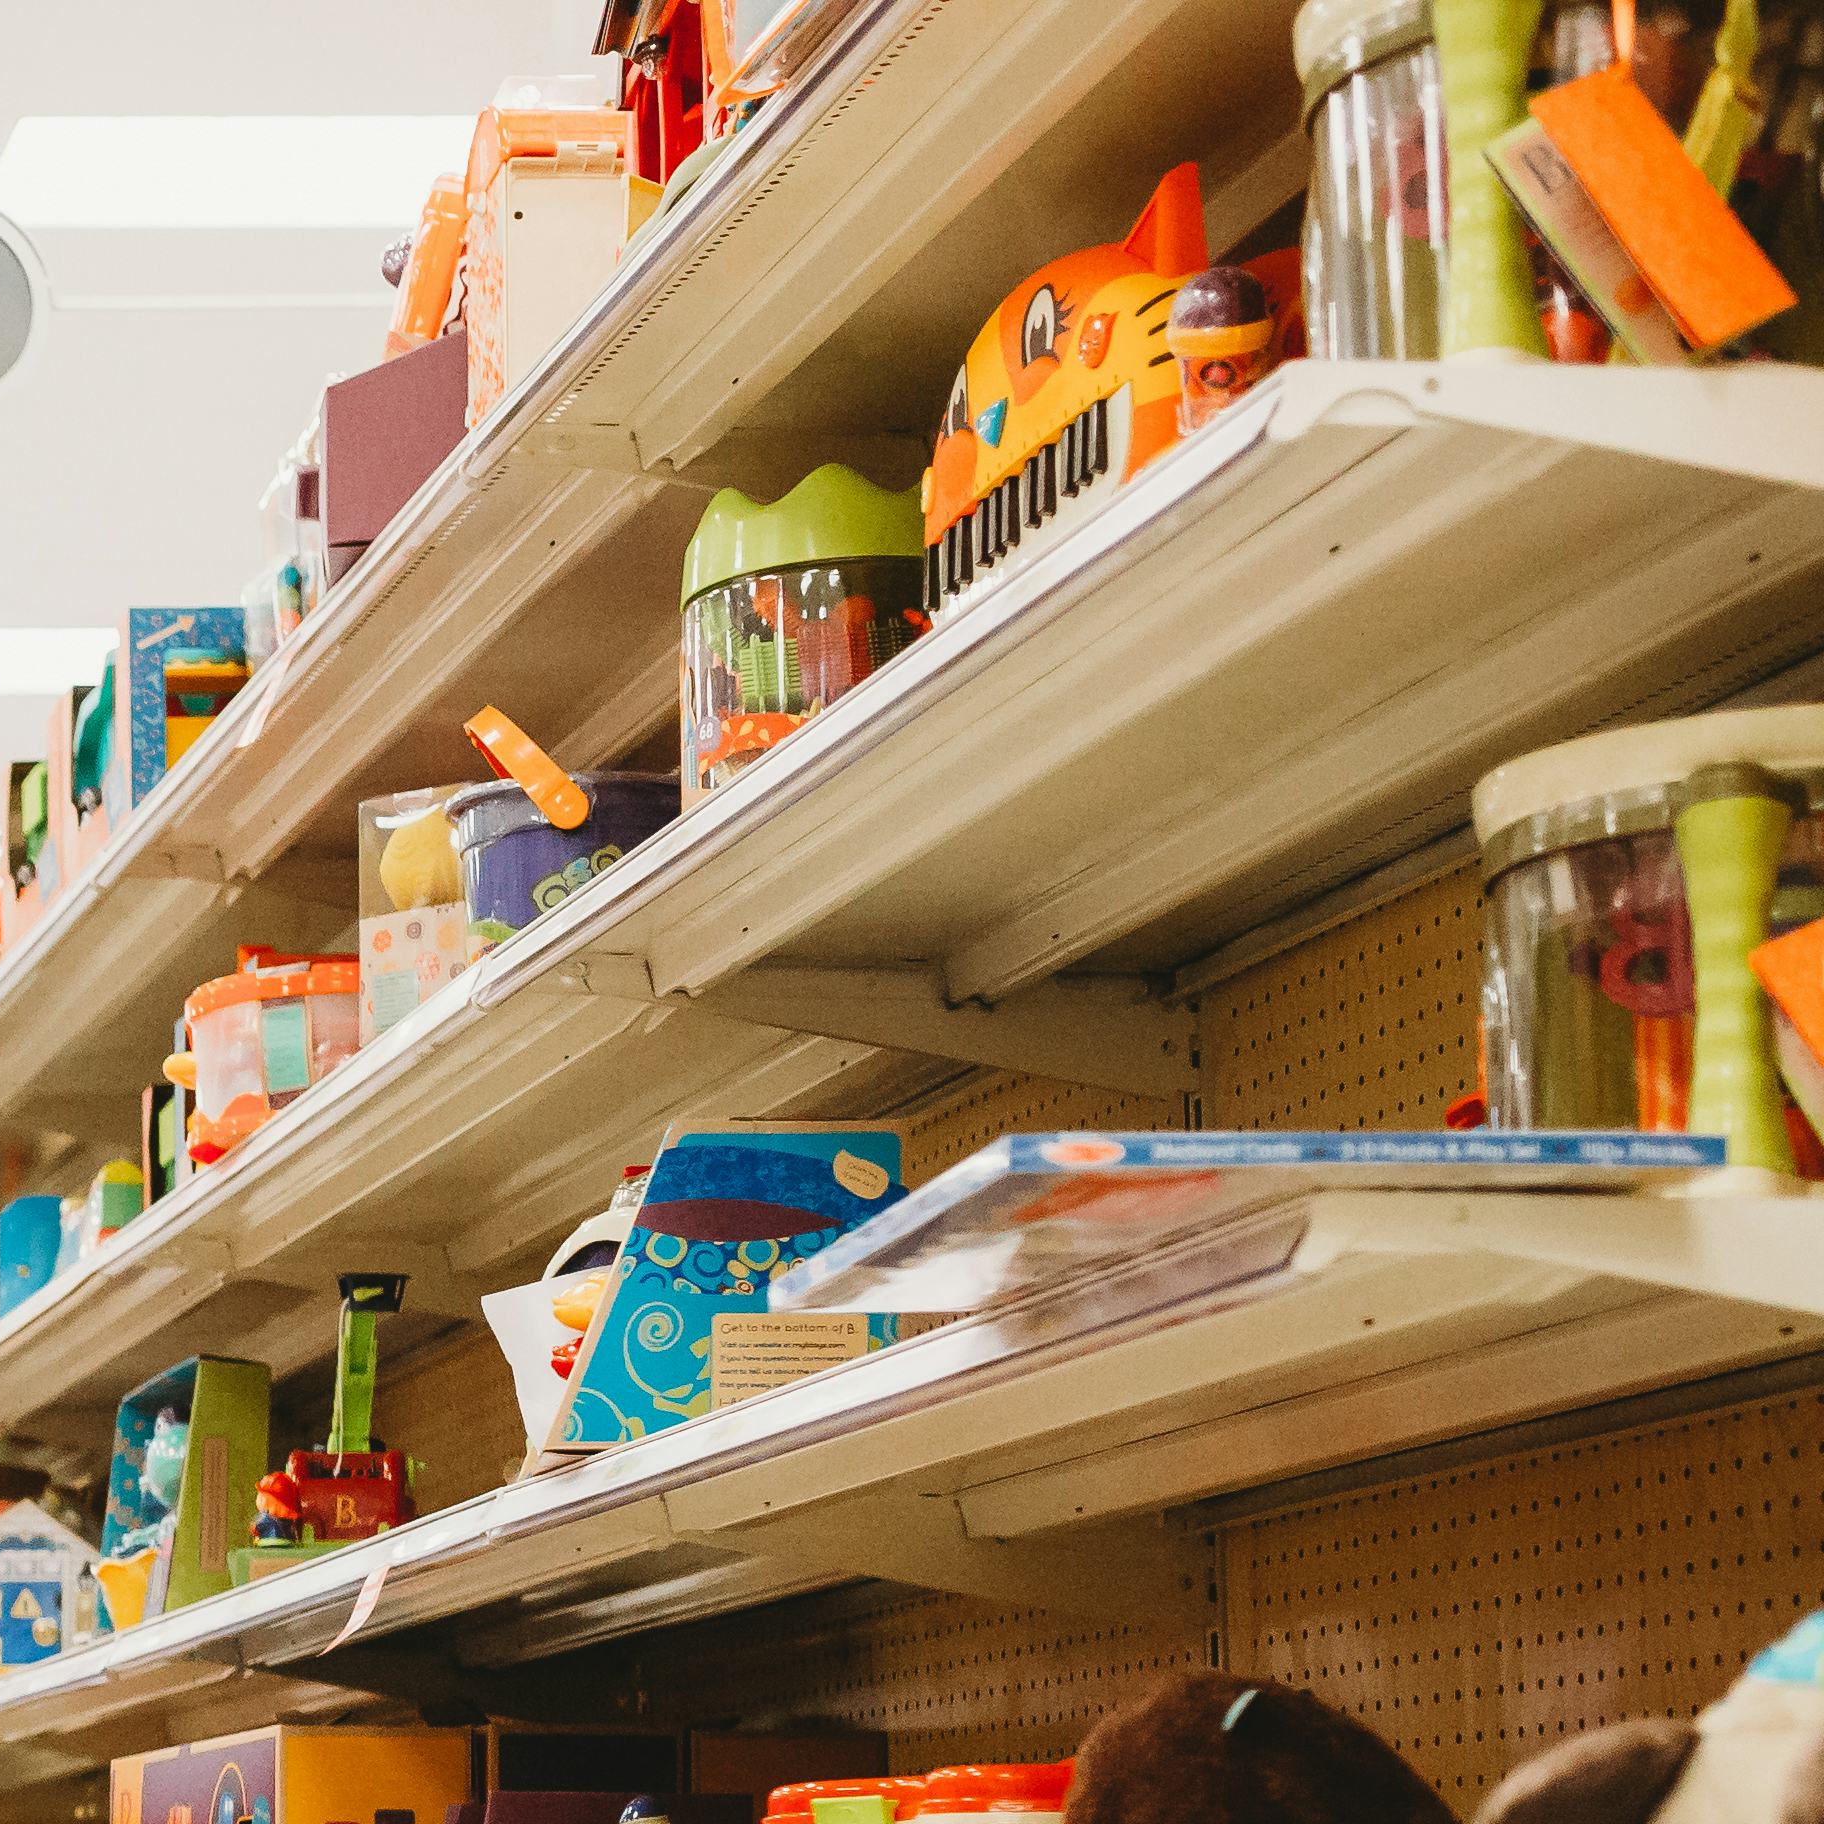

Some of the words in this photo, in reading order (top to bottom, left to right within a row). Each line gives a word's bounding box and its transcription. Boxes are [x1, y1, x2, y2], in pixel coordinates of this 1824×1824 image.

[720, 1323, 744, 1334] Get
[746, 1323, 758, 1332] to
[762, 1323, 781, 1332] the
[785, 1323, 828, 1332] bottom
[832, 1323, 843, 1335] of
